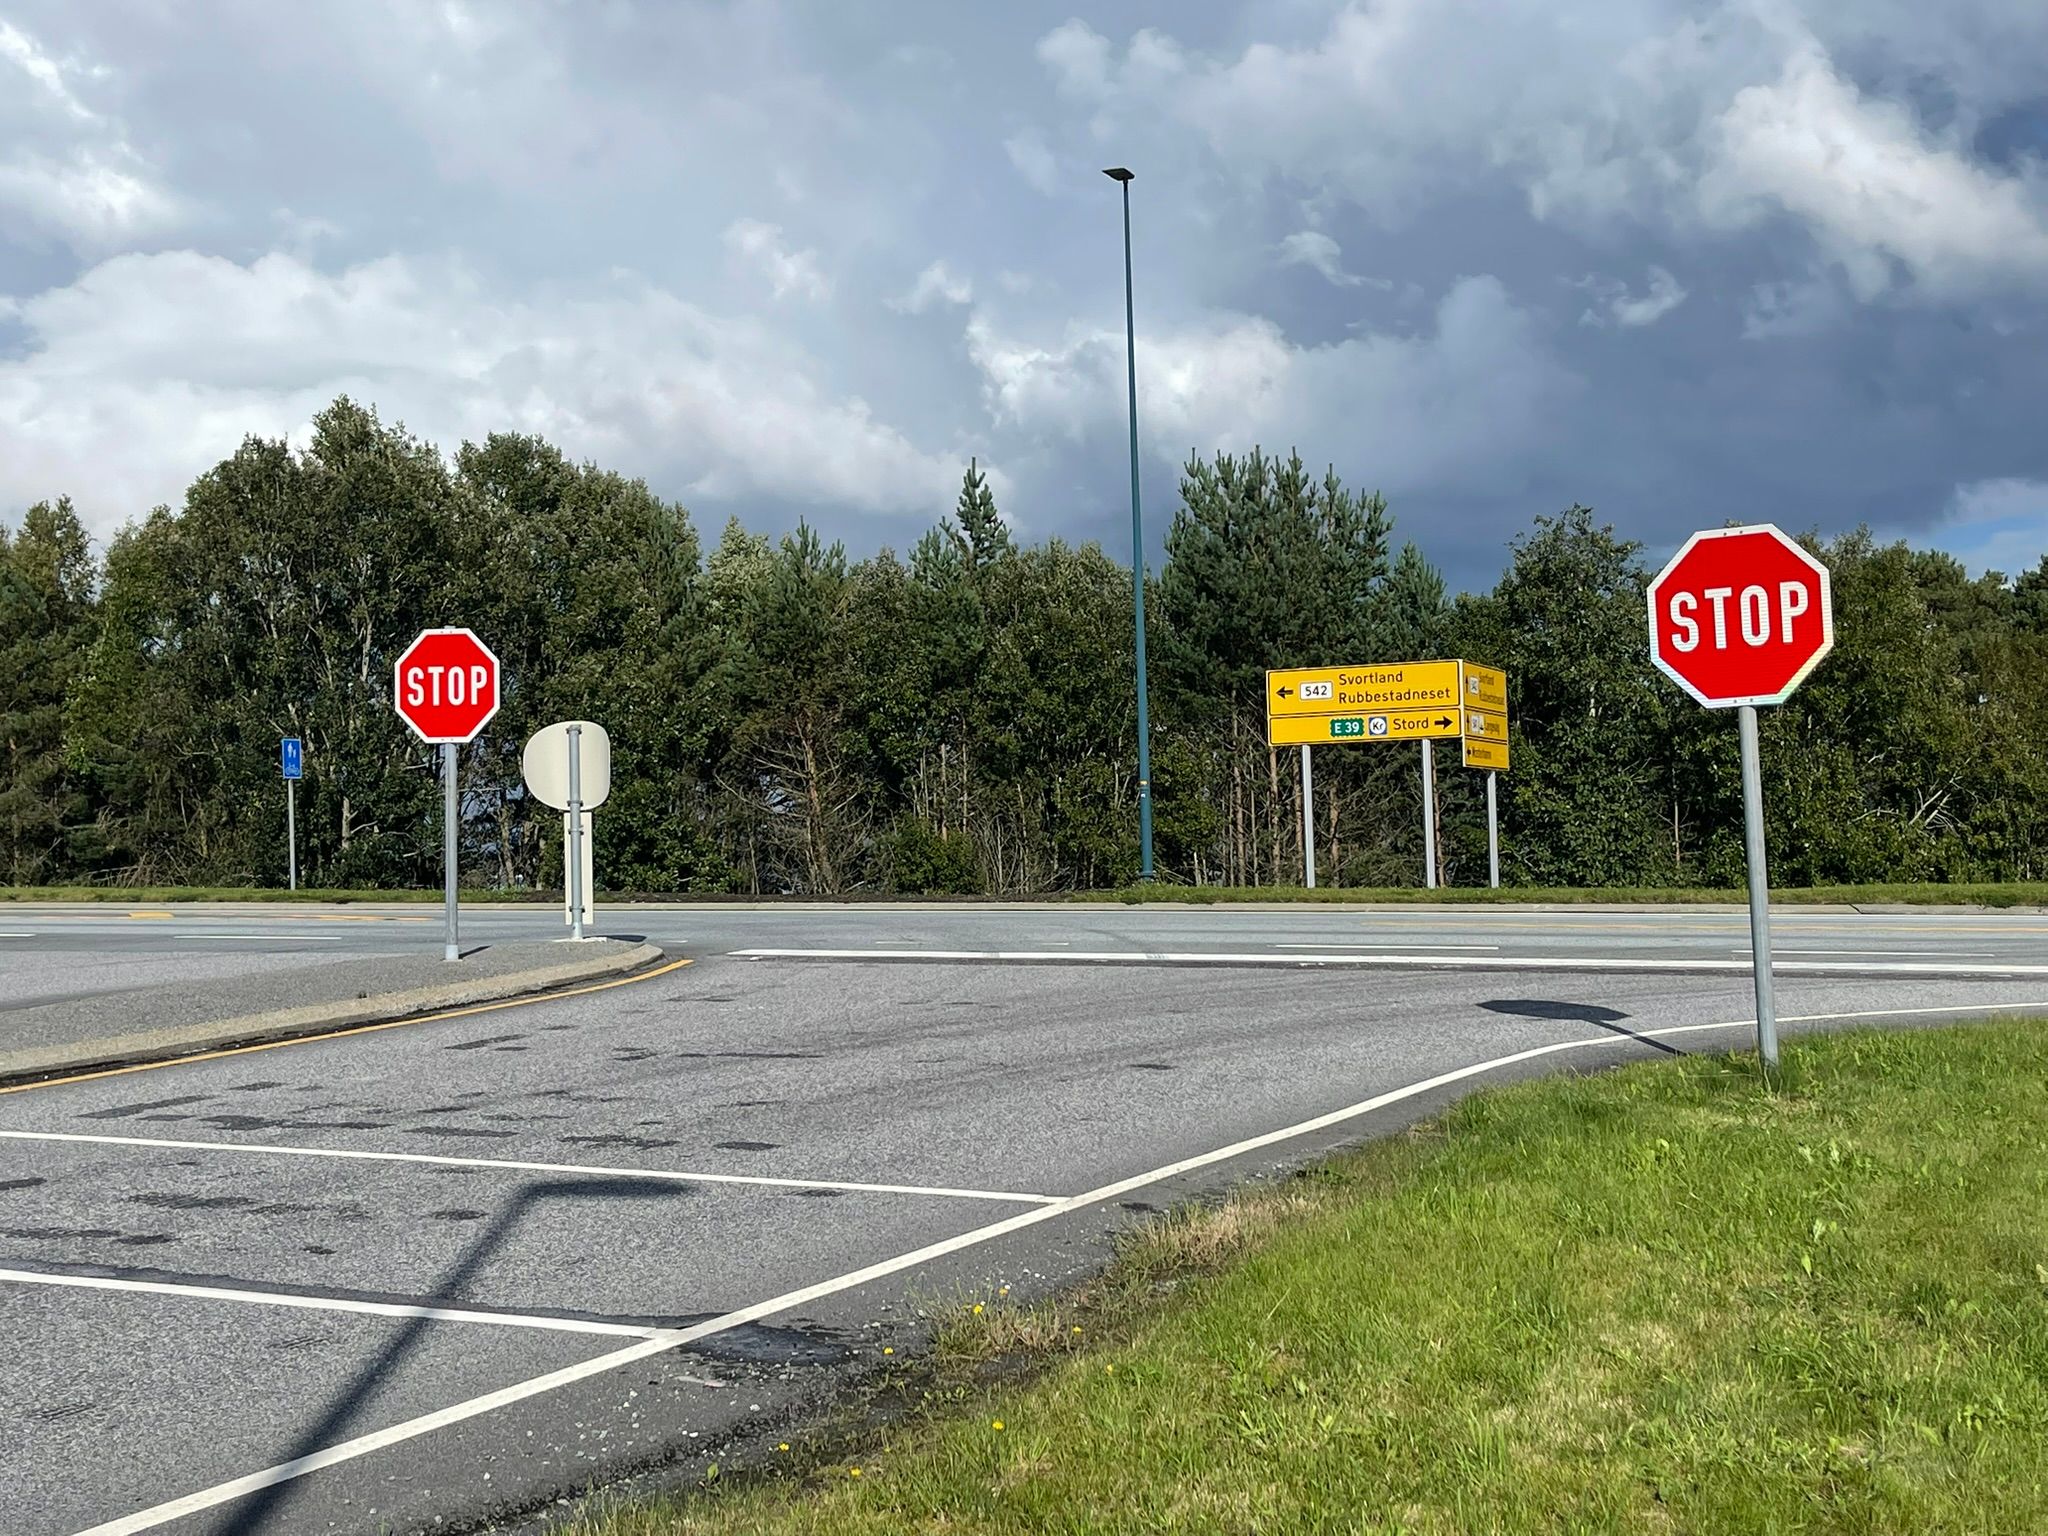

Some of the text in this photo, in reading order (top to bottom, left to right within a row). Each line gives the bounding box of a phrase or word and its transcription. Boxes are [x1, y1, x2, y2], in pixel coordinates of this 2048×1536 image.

[1670, 581, 1809, 652] STOP
[407, 665, 488, 707] STOP
[1338, 671, 1403, 686] Svortland
[1304, 685, 1328, 697] 542
[1338, 687, 1451, 704] Rubbestadneset
[1334, 717, 1429, 734] E 39 Kr Stord
